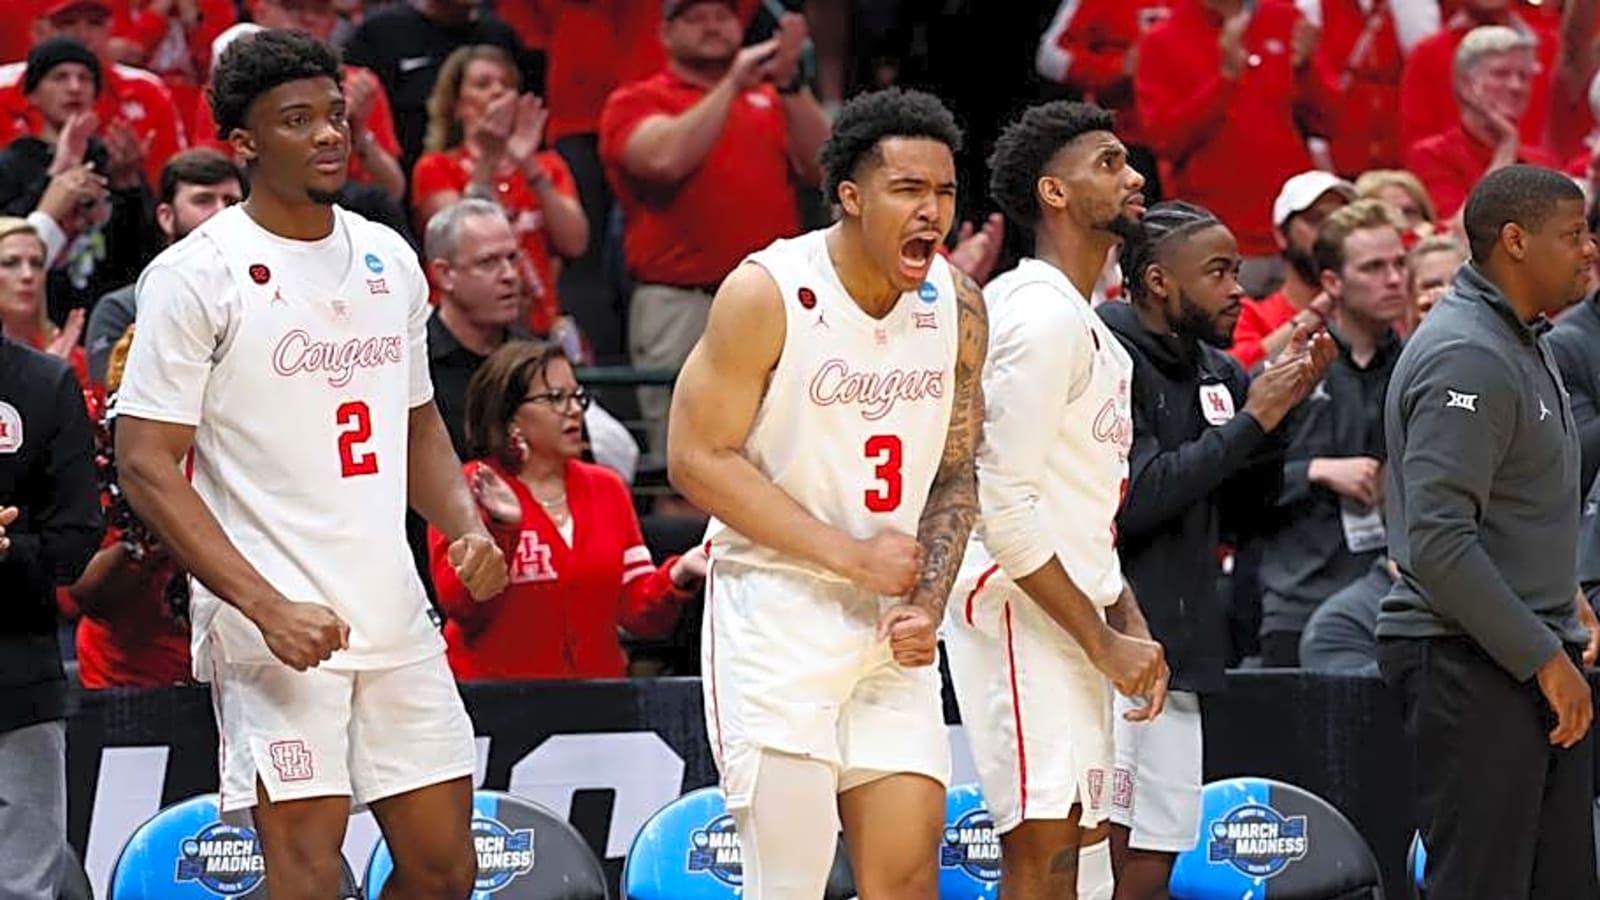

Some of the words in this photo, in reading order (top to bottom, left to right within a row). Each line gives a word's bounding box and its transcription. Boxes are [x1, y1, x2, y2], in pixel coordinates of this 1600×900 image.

[273, 329, 402, 388] Cougars
[809, 359, 945, 420] Cougars
[336, 401, 379, 478] 2
[864, 434, 902, 513] 3
[960, 828, 1000, 844] MARC
[1228, 823, 1278, 839] MARCH
[199, 840, 254, 857] MARCH
[474, 836, 505, 853] RCH
[967, 844, 1001, 860] MAD
[1236, 837, 1305, 854] MADNESS
